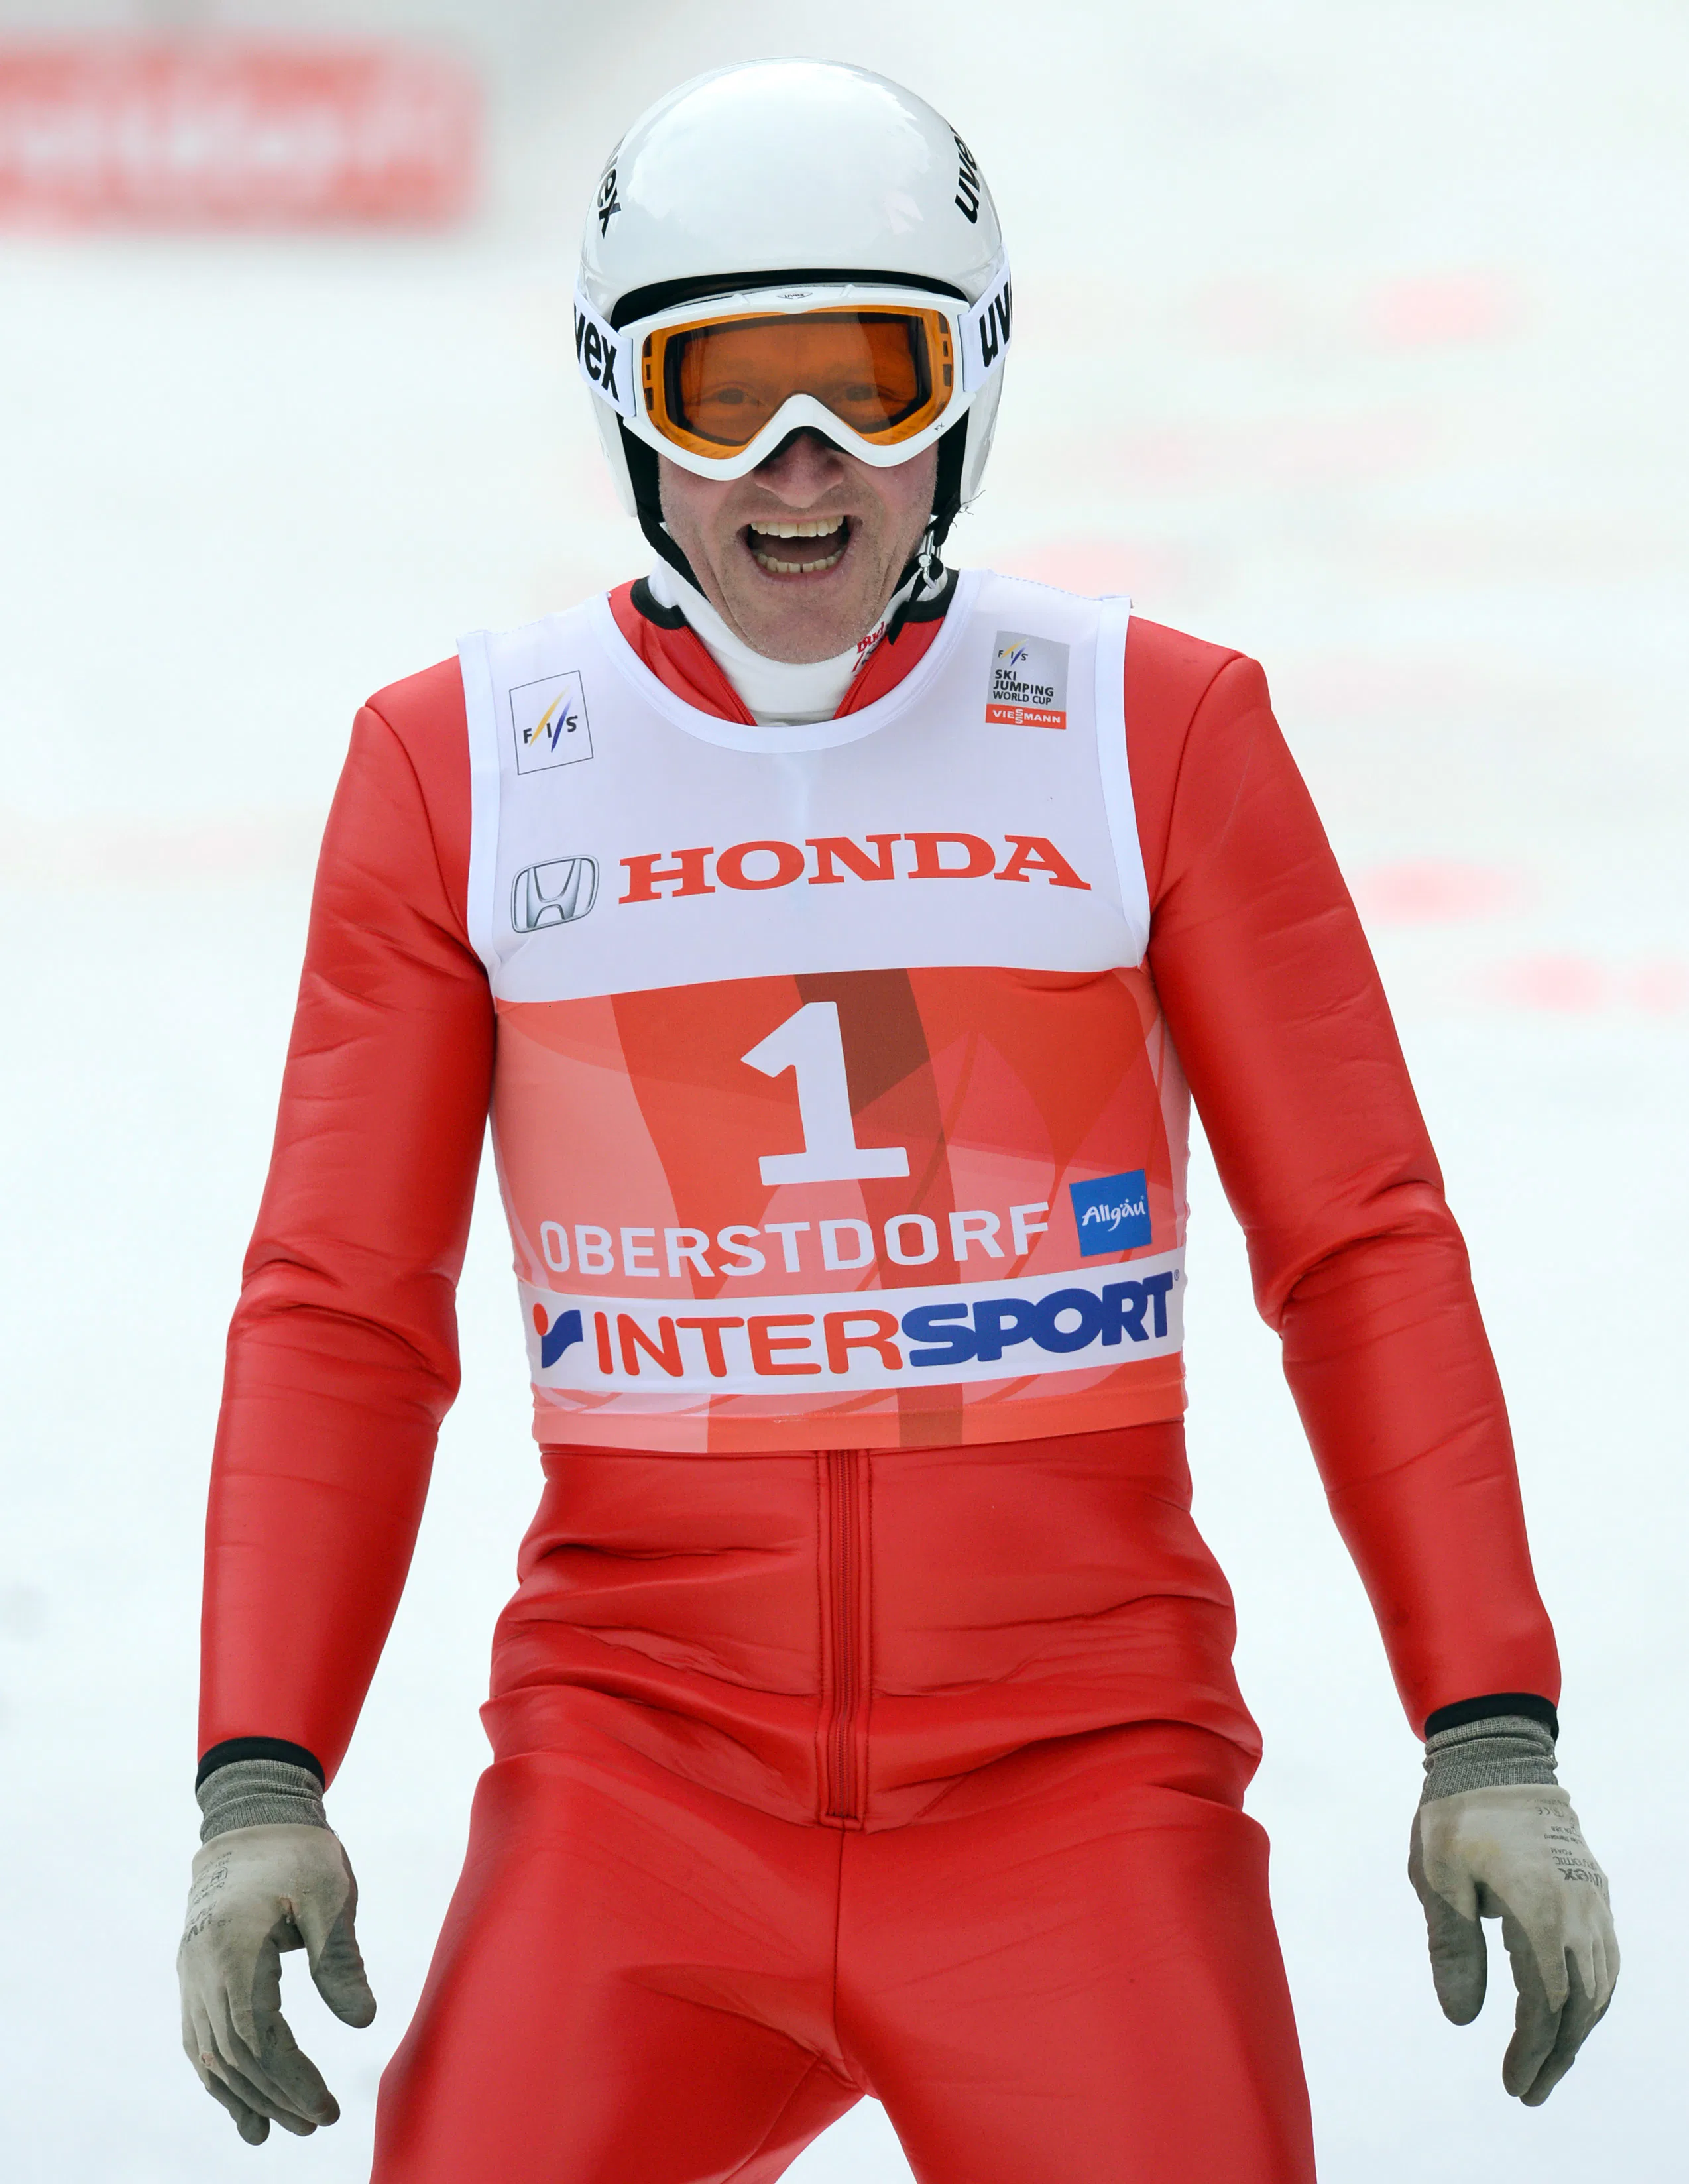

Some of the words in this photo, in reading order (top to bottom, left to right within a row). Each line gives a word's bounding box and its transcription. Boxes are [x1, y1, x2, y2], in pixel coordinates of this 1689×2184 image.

[597, 155, 622, 239] ex
[949, 125, 980, 224] uve
[573, 302, 620, 403] vex
[979, 281, 1010, 367] uv
[993, 680, 1054, 697] JUMPING
[995, 669, 1017, 681] SKI
[998, 650, 1028, 661] FIS
[993, 691, 1029, 702] WORLD
[1032, 695, 1052, 705] CUP
[618, 832, 1092, 904] HONDA
[740, 1000, 911, 1186] 1
[540, 1201, 1049, 1278] OBERSTDORF
[1082, 1198, 1145, 1232] Allgäu
